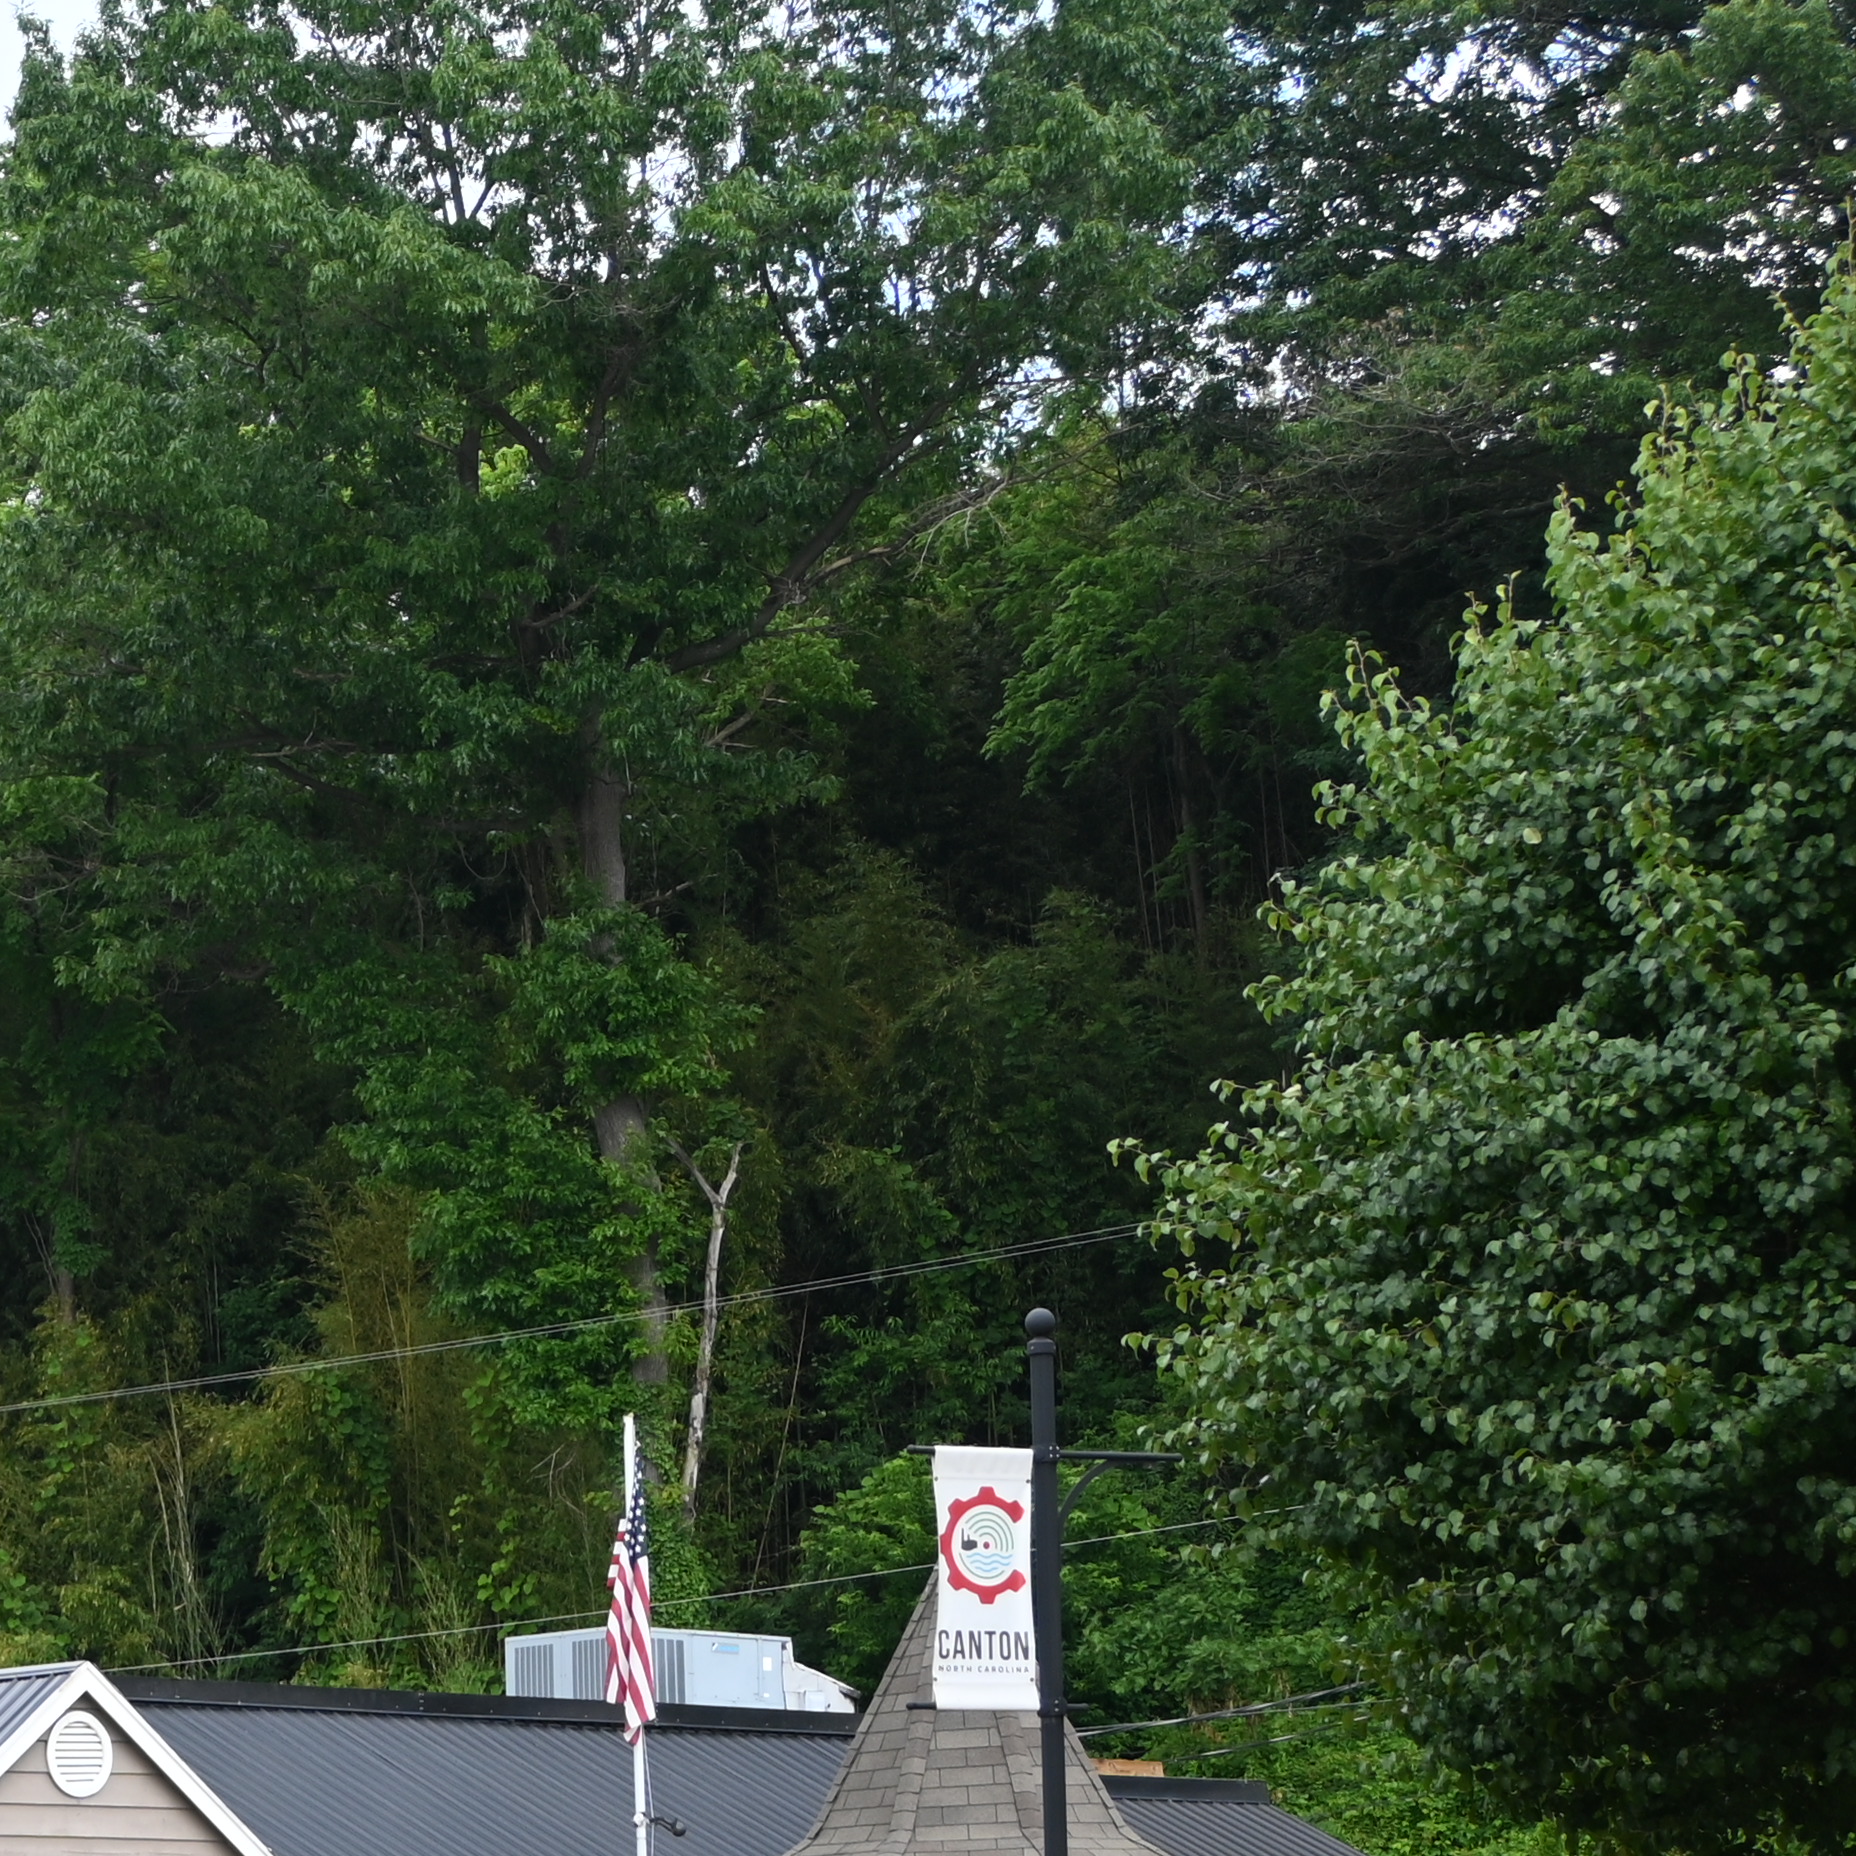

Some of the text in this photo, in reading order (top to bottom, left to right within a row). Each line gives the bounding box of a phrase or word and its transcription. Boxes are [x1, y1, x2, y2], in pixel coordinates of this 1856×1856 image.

[938, 1629, 1030, 1661] CANTON
[938, 1665, 1030, 1674] NORTH CAROLINA
